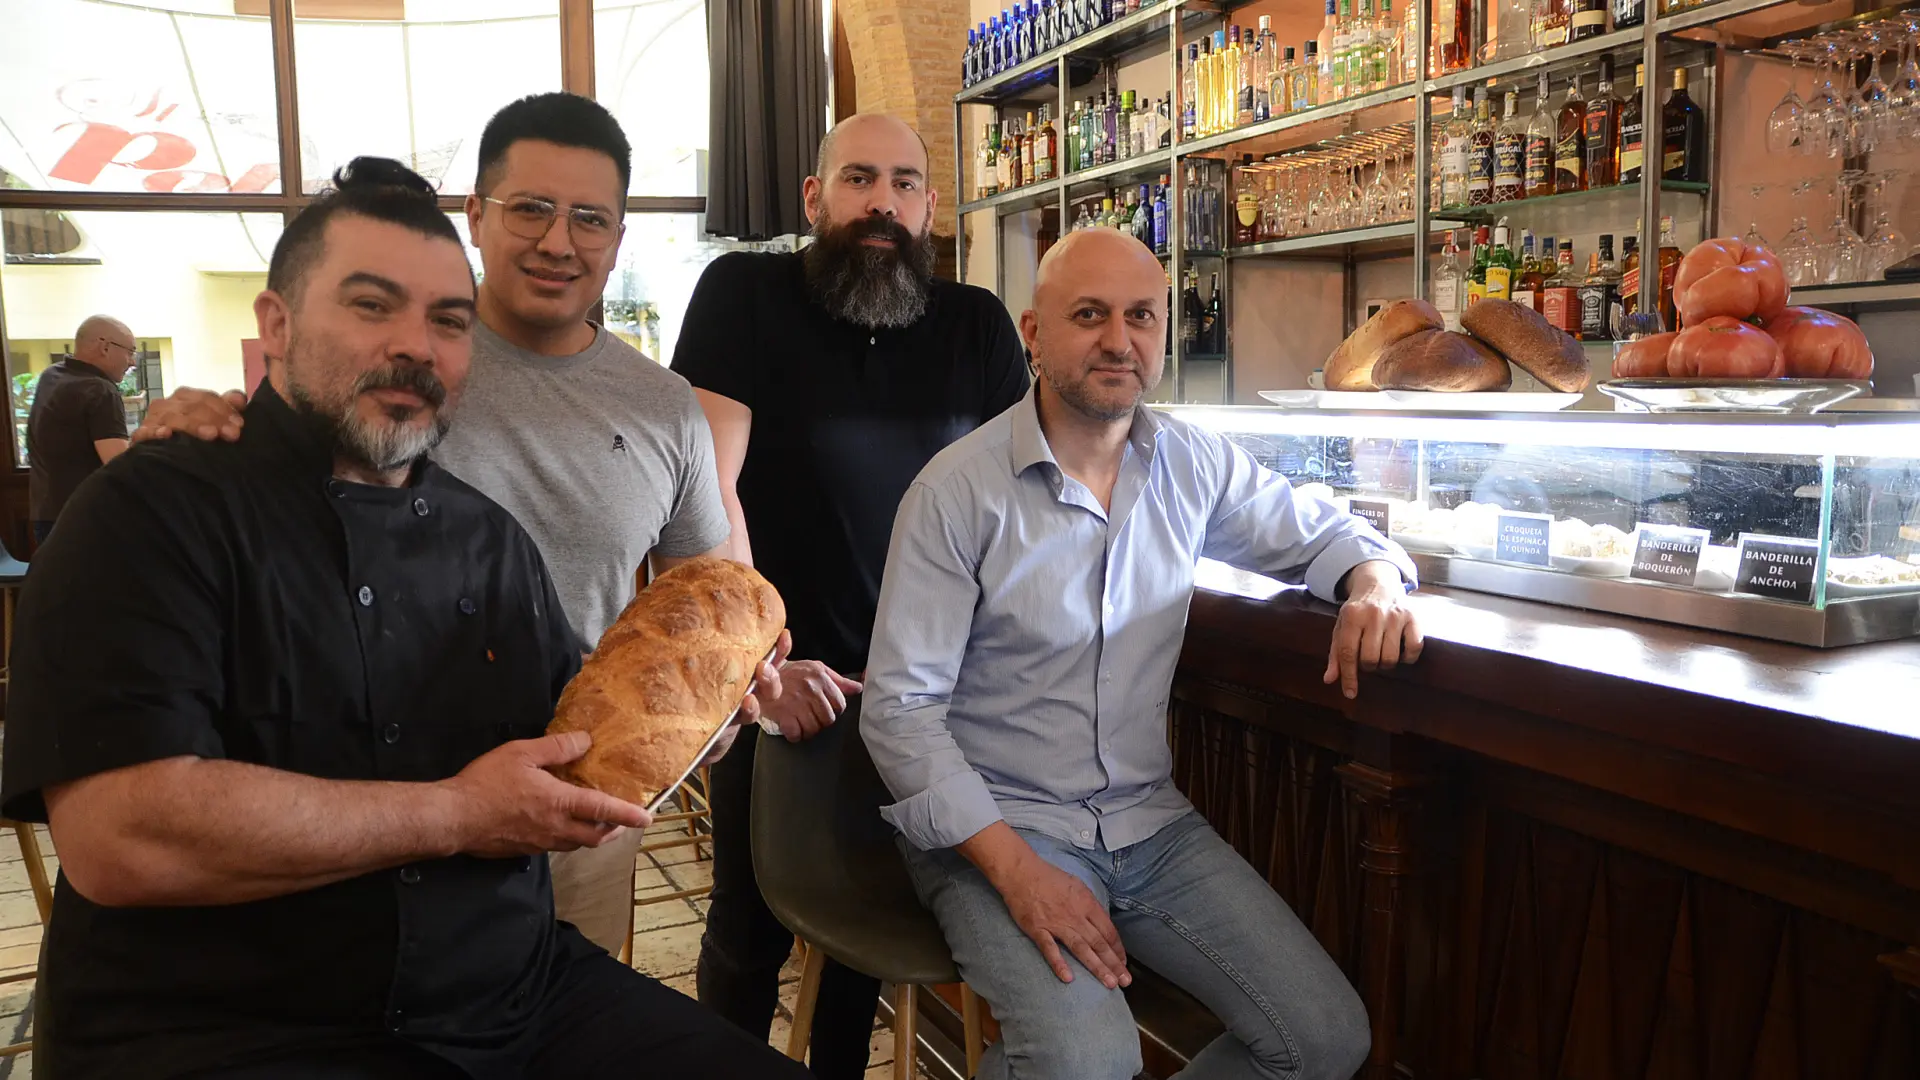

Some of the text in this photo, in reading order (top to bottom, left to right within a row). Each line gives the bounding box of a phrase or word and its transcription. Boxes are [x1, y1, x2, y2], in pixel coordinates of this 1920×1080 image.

[1352, 508, 1384, 518] FINGERS DE
[1504, 525, 1543, 535] CROQUETA
[1501, 534, 1547, 546] DE ESPINACA
[1505, 544, 1541, 555] Y QUINOA
[1641, 540, 1698, 554] BANDERILLA
[1661, 553, 1673, 562] DE
[1745, 550, 1813, 566] BANDERILLA
[1638, 562, 1691, 576] BOQUERÓN
[1768, 566, 1784, 576] DE
[1749, 576, 1797, 590] ANCHOA
